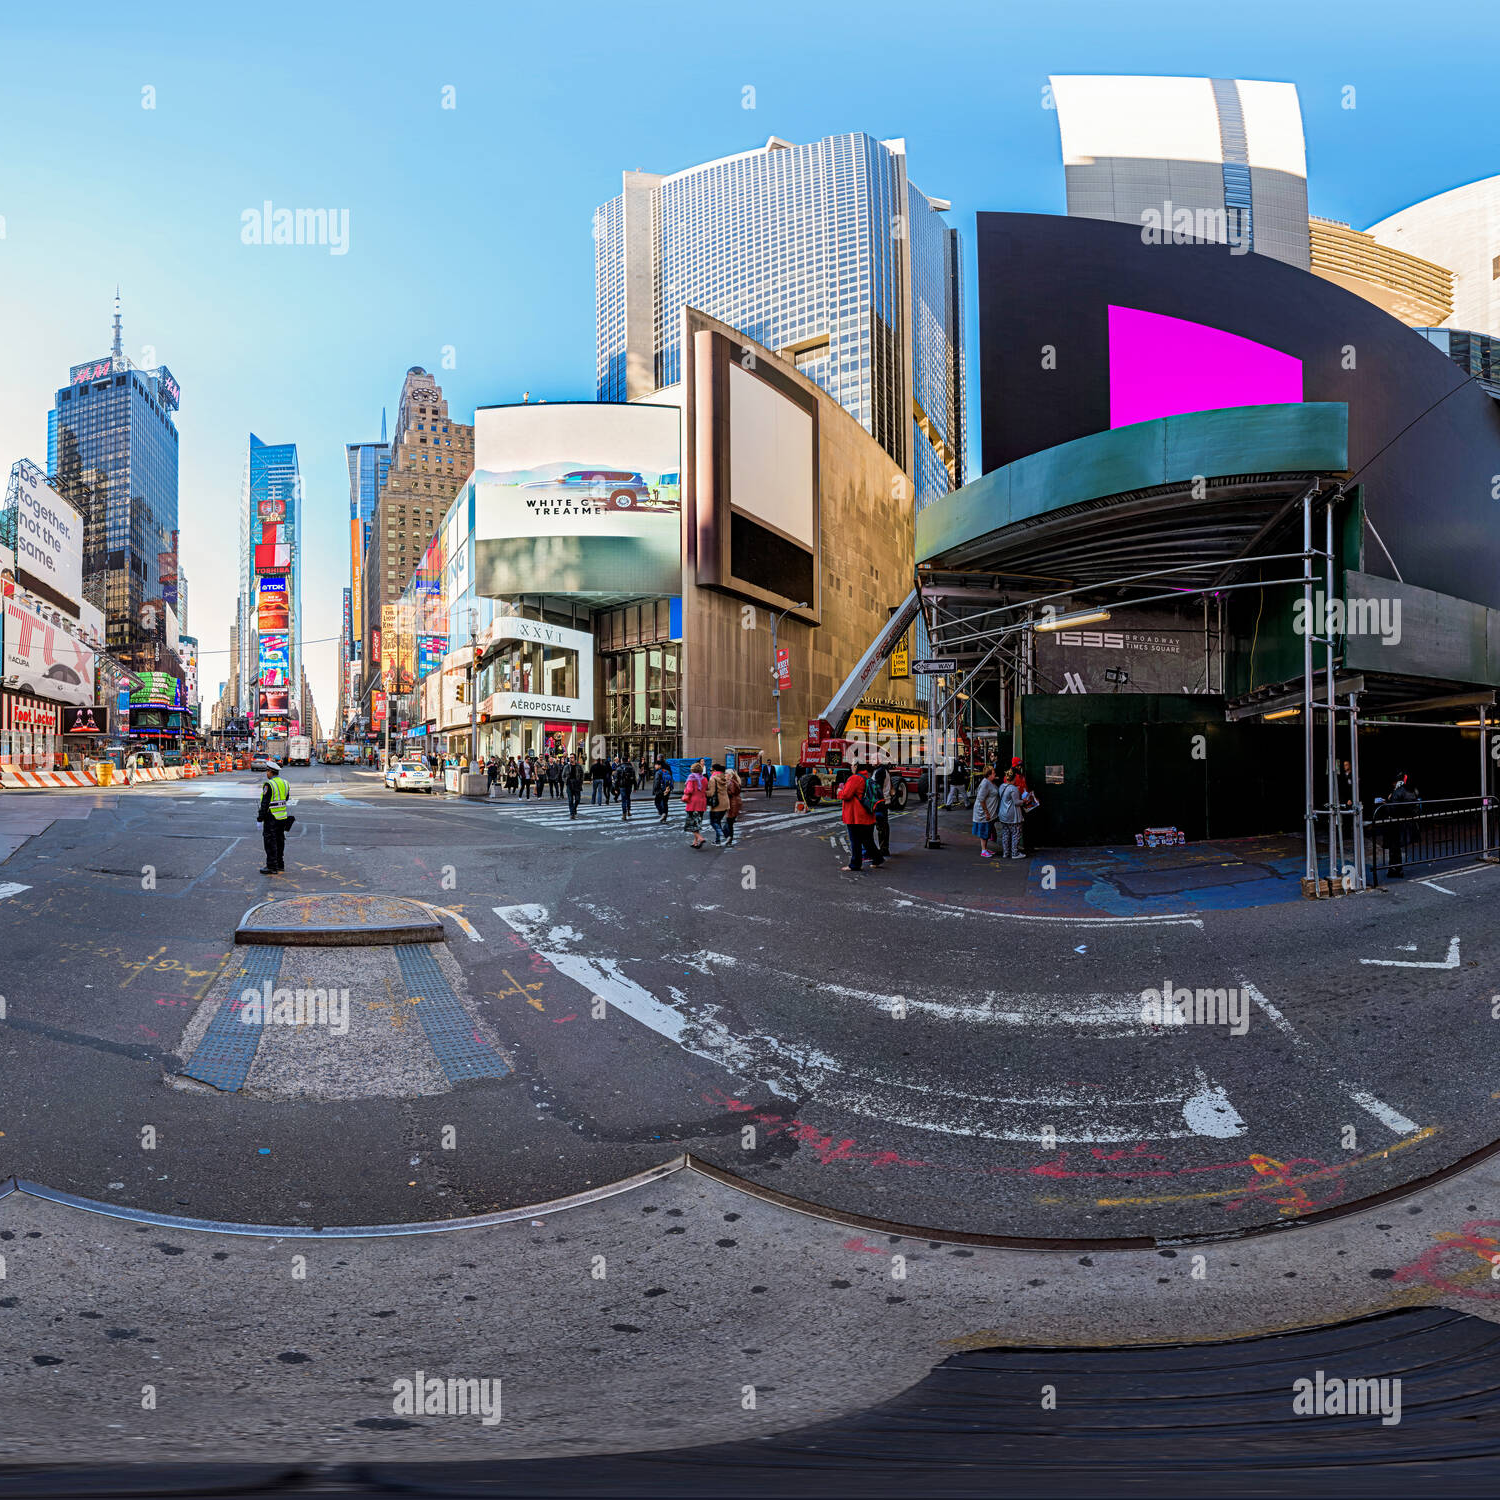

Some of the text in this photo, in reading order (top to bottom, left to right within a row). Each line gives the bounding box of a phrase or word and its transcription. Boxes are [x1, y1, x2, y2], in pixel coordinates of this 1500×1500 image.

[73, 361, 111, 385] H&M
[20, 464, 38, 489] be
[19, 486, 71, 540] together.
[526, 499, 572, 507] WHITE
[19, 511, 61, 553] not the
[18, 536, 56, 572] same.
[520, 622, 565, 644] XXVI
[1052, 632, 1124, 649] 1535
[1125, 634, 1181, 644] BROADWAY
[8, 604, 93, 685] TLX
[1126, 643, 1180, 653] TIMES SQUARE
[11, 656, 31, 668] ACURA
[14, 705, 56, 726] Foot Locker
[510, 698, 571, 714] AÉROPOSTALE
[855, 713, 915, 732] THE LION KING
